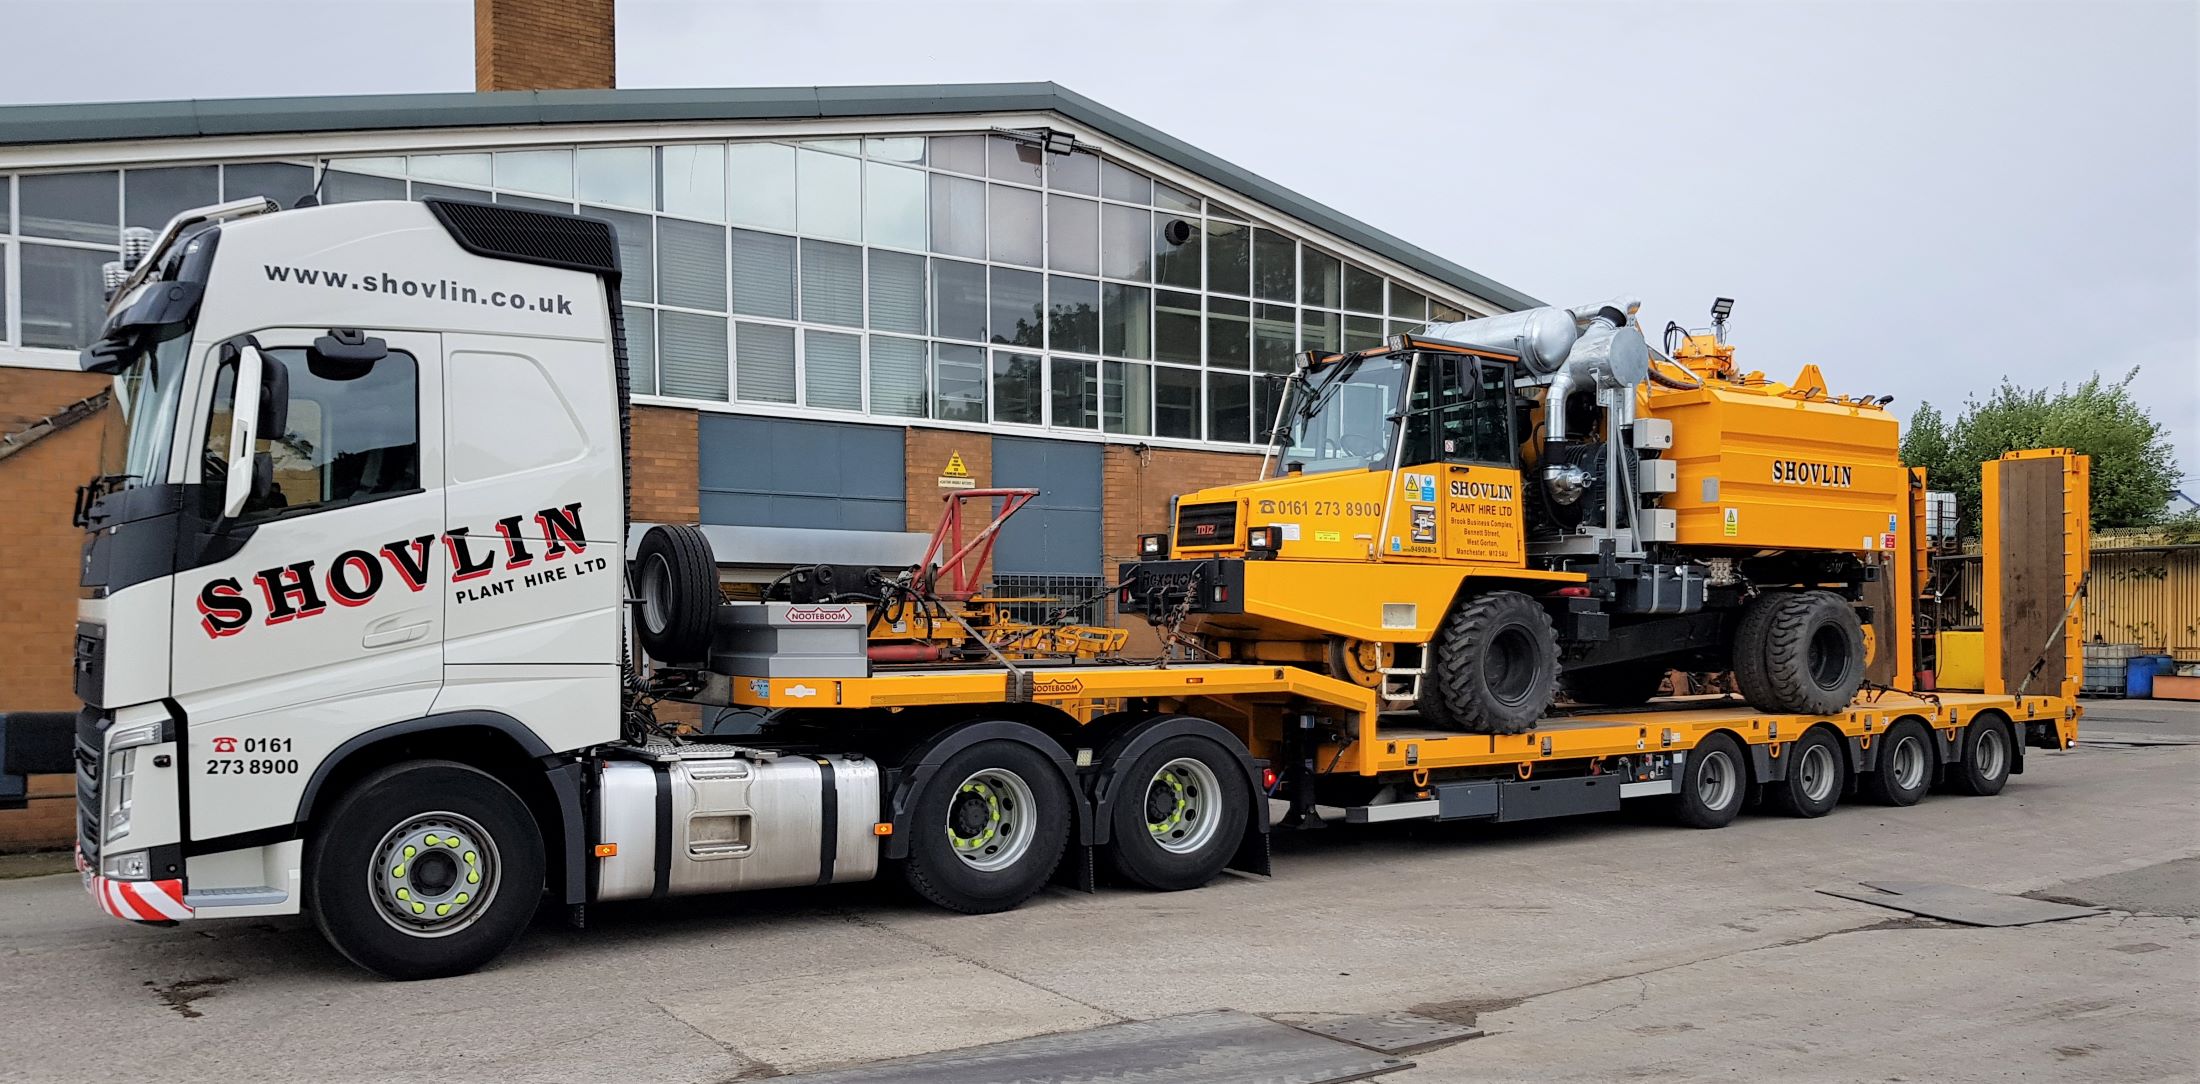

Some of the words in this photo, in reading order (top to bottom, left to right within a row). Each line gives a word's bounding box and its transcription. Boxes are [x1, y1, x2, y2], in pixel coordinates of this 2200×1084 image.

[264, 265, 573, 315] www.shovlin.co.uk
[1772, 460, 1852, 488] SHOVLIN
[1450, 480, 1513, 501] SHOVLIN
[1278, 500, 1308, 515] 0161
[1314, 501, 1340, 516] 273
[1346, 502, 1381, 517] 8900
[1450, 502, 1475, 514] PLANT
[1478, 504, 1497, 515] HIRE
[1499, 506, 1513, 517] LTD
[1450, 516, 1466, 525] Brook
[1467, 518, 1490, 527] Business
[196, 502, 588, 639] SHOVLIN
[1142, 570, 1198, 589] Rexquot
[455, 579, 515, 605] PLANT
[525, 566, 568, 589] HIRE
[574, 556, 607, 577] LTD
[244, 737, 292, 753] 0161
[206, 759, 244, 775] 273
[249, 759, 299, 775] 8900
